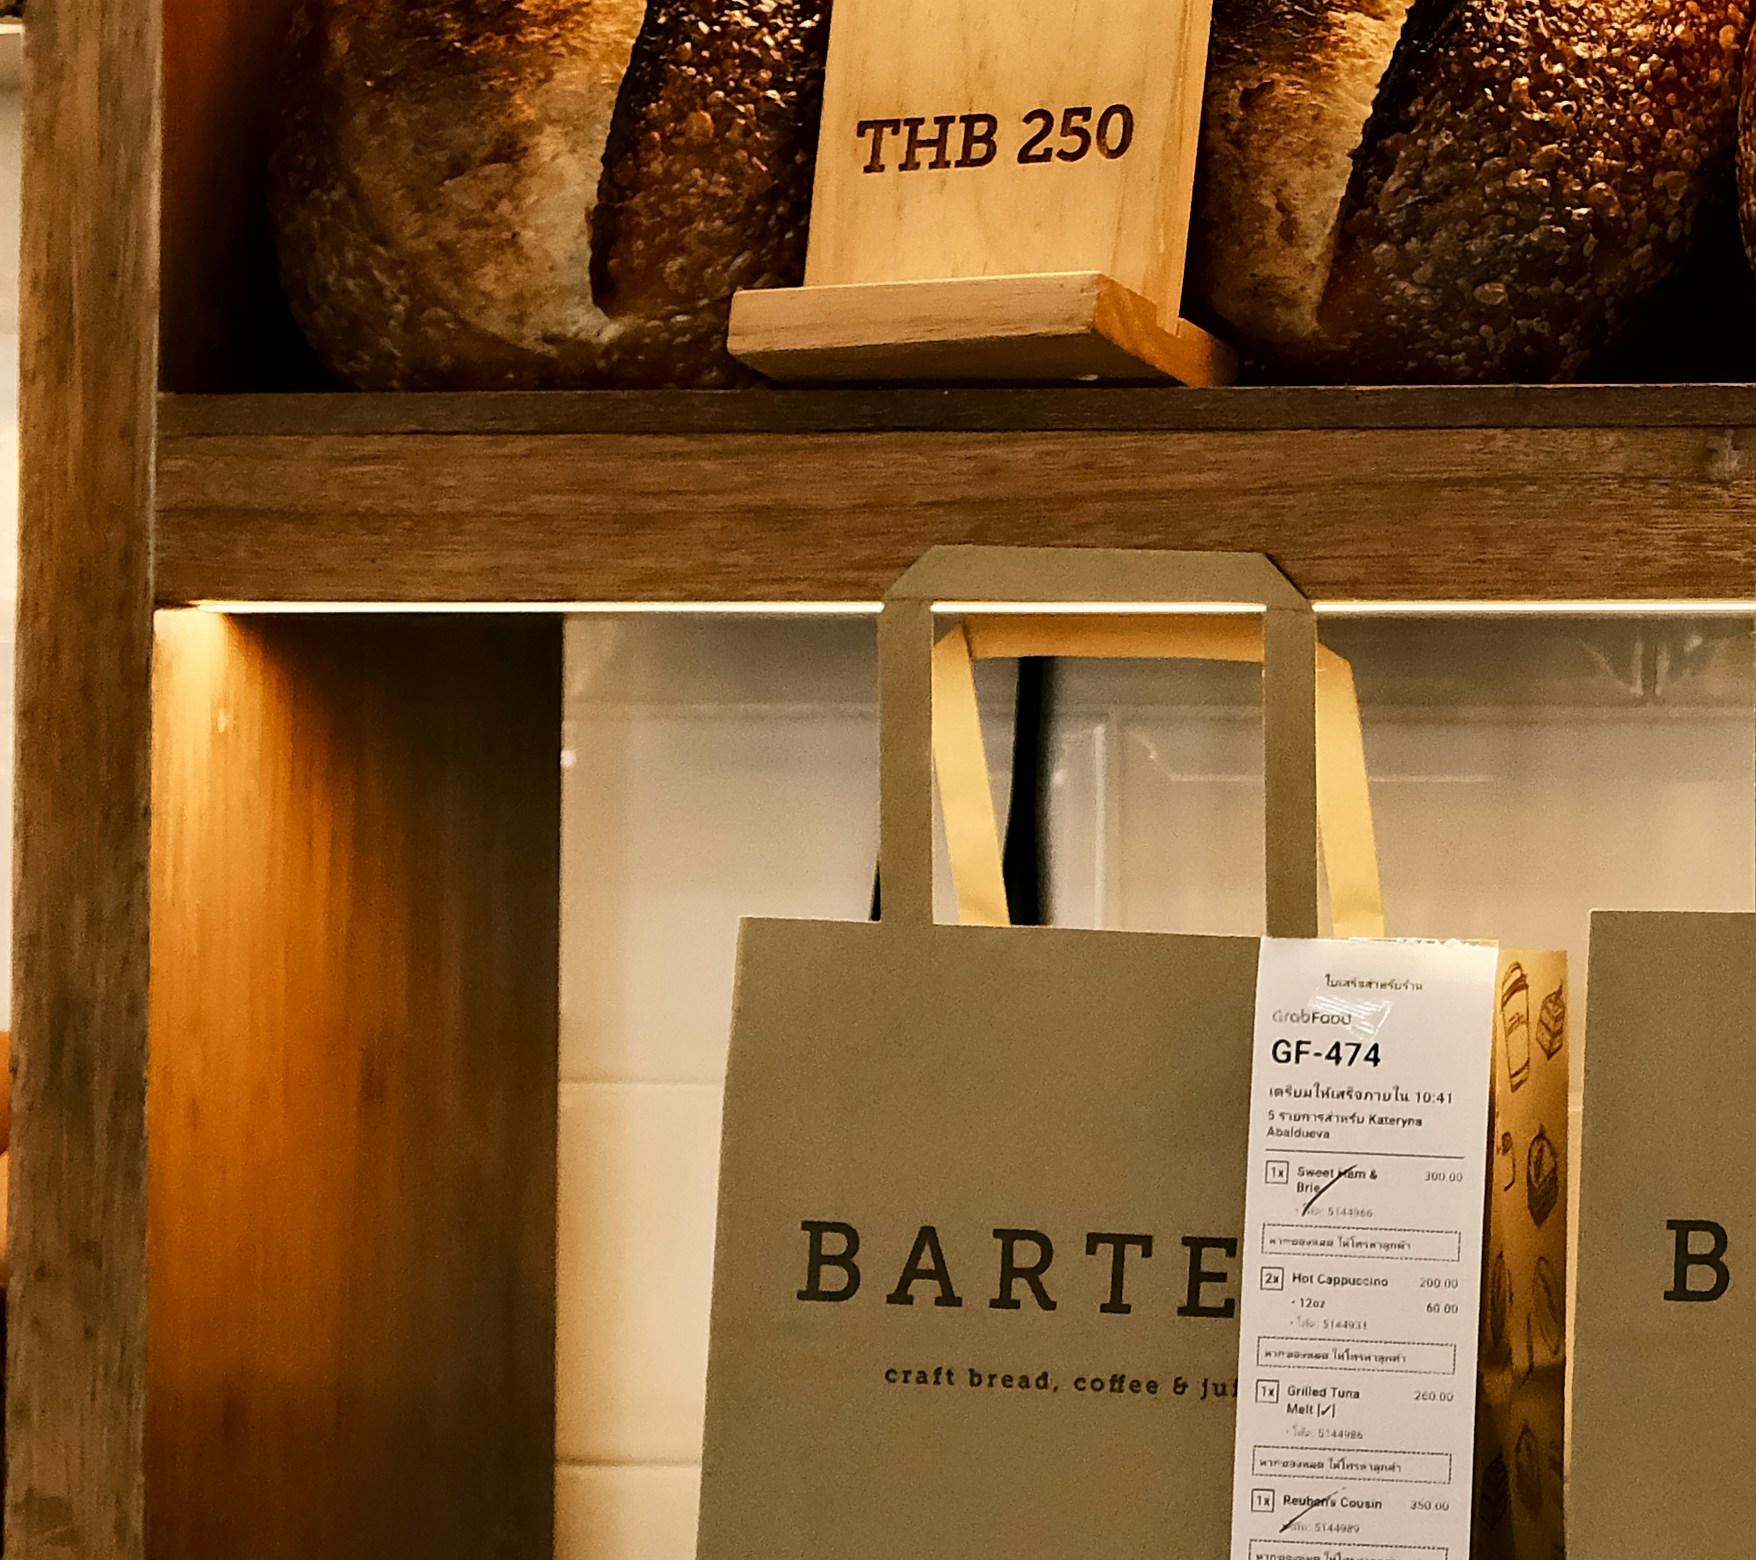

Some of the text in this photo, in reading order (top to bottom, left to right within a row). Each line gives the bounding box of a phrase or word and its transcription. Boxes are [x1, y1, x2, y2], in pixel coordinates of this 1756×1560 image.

[857, 103, 1135, 174] THB 250
[1271, 1038, 1381, 1067] GF-474
[1269, 1082, 1453, 1104] เตรียมให้เสร็จภายใน 10:41
[1368, 1114, 1423, 1128] Kateryna
[1271, 1167, 1284, 1178] 1x
[1296, 1166, 1334, 1179] Sweet
[1369, 1169, 1378, 1180] &
[1424, 1171, 1463, 1182] 300.00
[1296, 1182, 1320, 1193] Brie
[796, 1219, 1238, 1319] BARTE
[1264, 1272, 1459, 1289] 2x Hot Cappuccino 200.00
[1299, 1297, 1459, 1314] 12oz 60.00
[884, 1367, 955, 1386] craft
[968, 1369, 1059, 1394] bread,
[1073, 1374, 1159, 1396] coffee
[1173, 1376, 1189, 1395] &
[1261, 1385, 1454, 1402] 1x Grilled Tuna 260.00
[1286, 1403, 1314, 1415] Melt
[1256, 1494, 1450, 1511] 1x Reuben's Cousin 350.00
